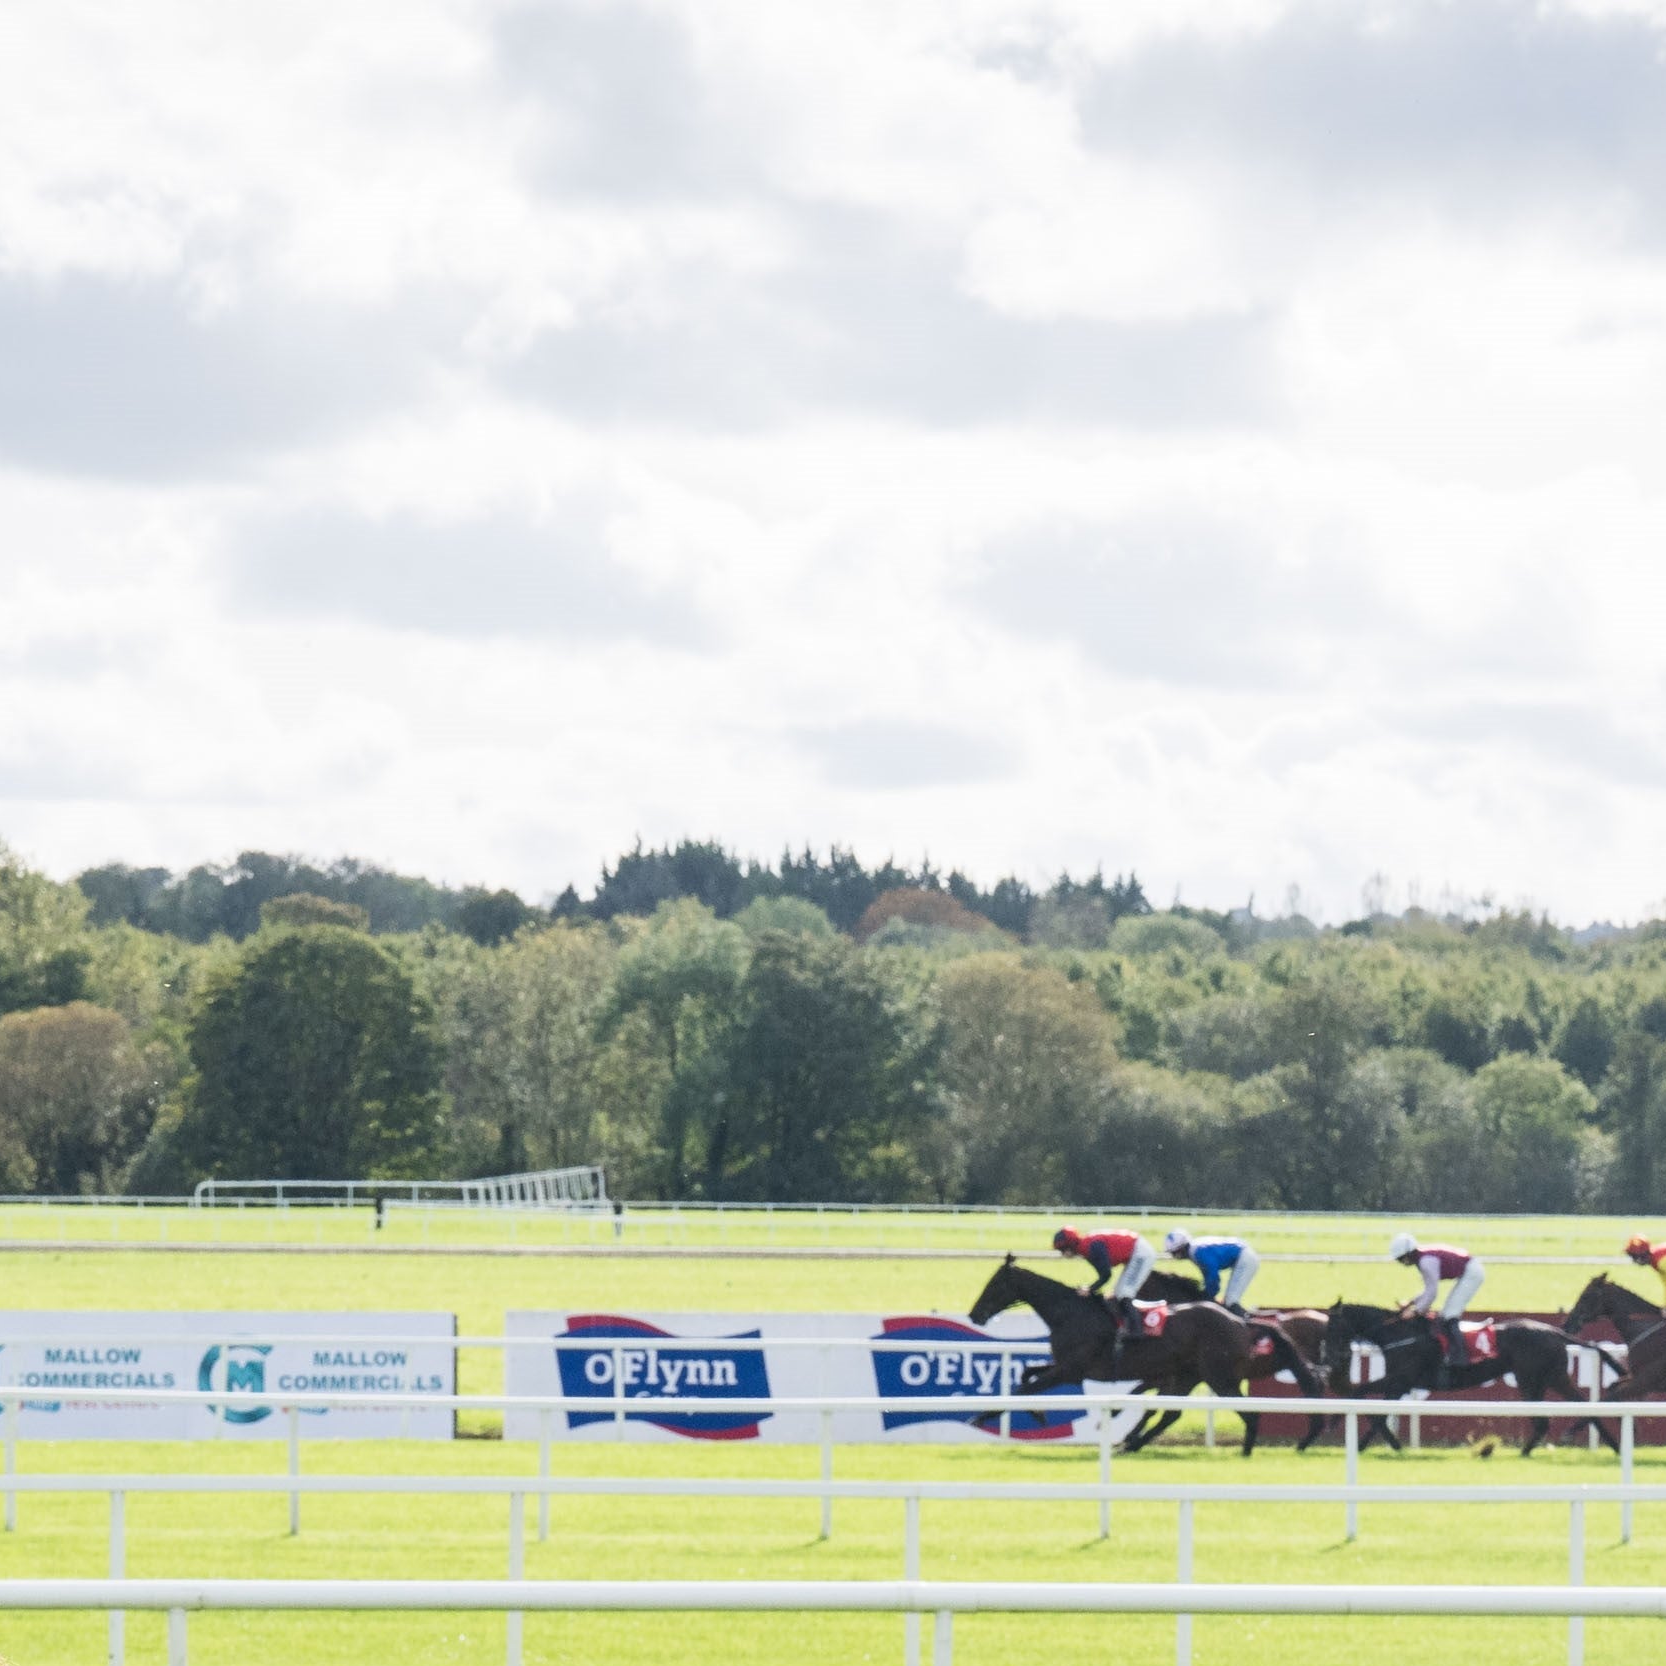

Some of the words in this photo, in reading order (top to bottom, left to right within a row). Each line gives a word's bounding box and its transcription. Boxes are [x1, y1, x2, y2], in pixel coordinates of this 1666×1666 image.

[45, 1348, 141, 1363] MALLOW
[313, 1351, 407, 1366] MALLOW
[17, 1372, 176, 1388] OMMERCIALS
[278, 1374, 443, 1391] COMMERCILS
